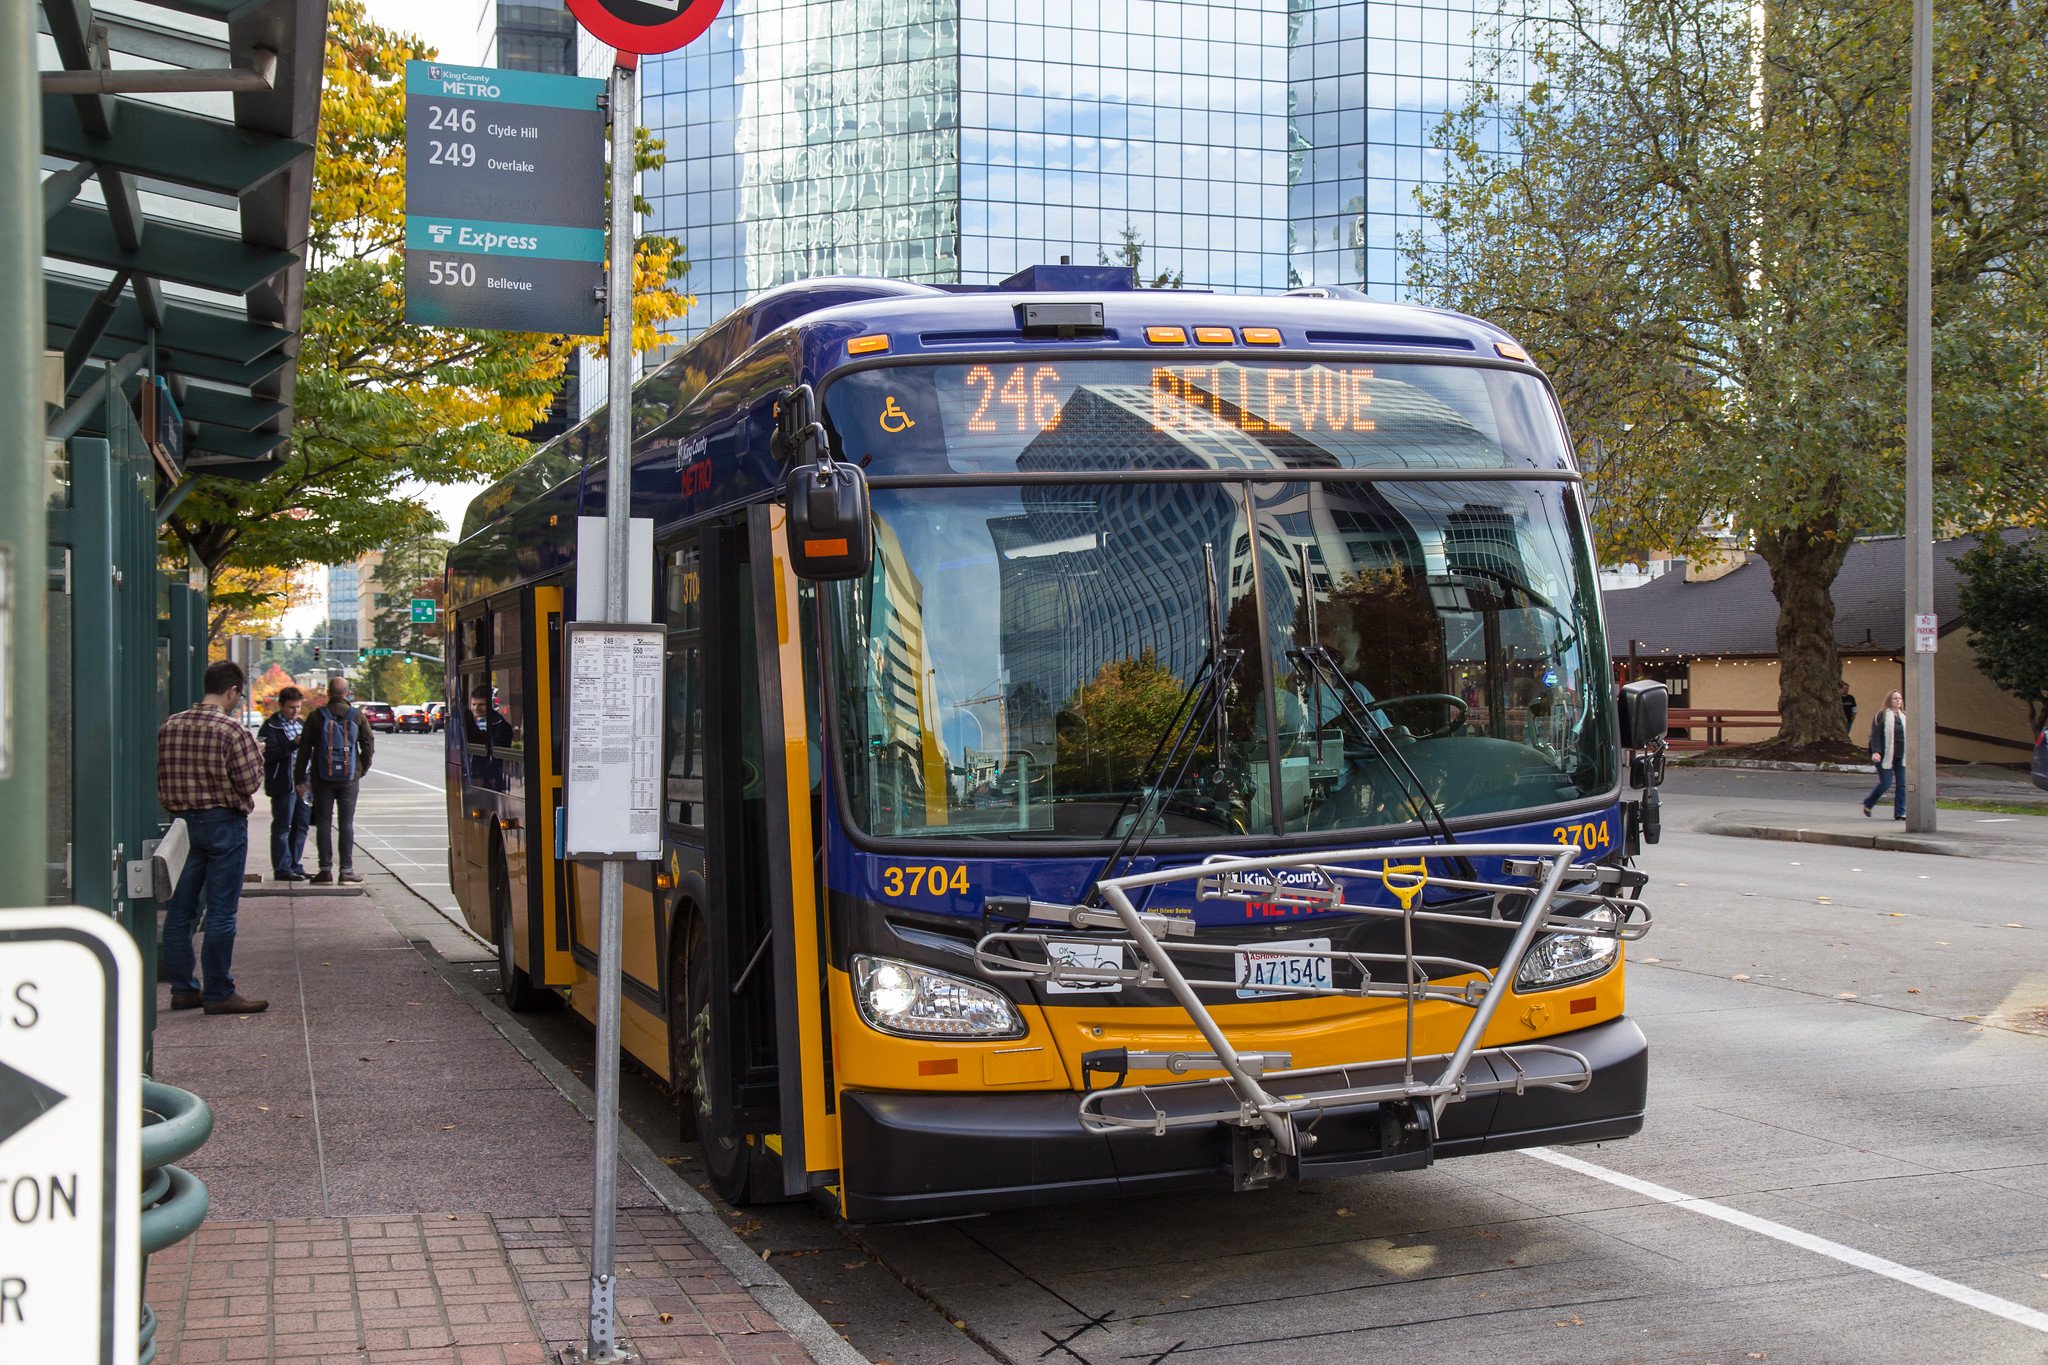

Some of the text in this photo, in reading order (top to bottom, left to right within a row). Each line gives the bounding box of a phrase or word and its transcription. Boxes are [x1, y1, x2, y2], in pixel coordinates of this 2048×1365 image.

[443, 71, 490, 84] King County
[443, 81, 501, 98] METRO
[428, 105, 538, 139] 246 Clyde Hill
[429, 140, 534, 173] 249 Overlake
[458, 227, 538, 252] Express
[429, 260, 532, 291] 550 Bellevue
[965, 366, 1376, 431] 246 BELLEVUE
[681, 458, 712, 499] METRO
[603, 637, 614, 645] 249
[633, 647, 643, 655] 550
[1553, 821, 1610, 850] 3704
[884, 865, 970, 897] 3704
[1244, 870, 1324, 886] Kin County
[1059, 947, 1069, 955] OK
[1255, 957, 1326, 985] A7154C
[0, 1173, 78, 1225] ON
